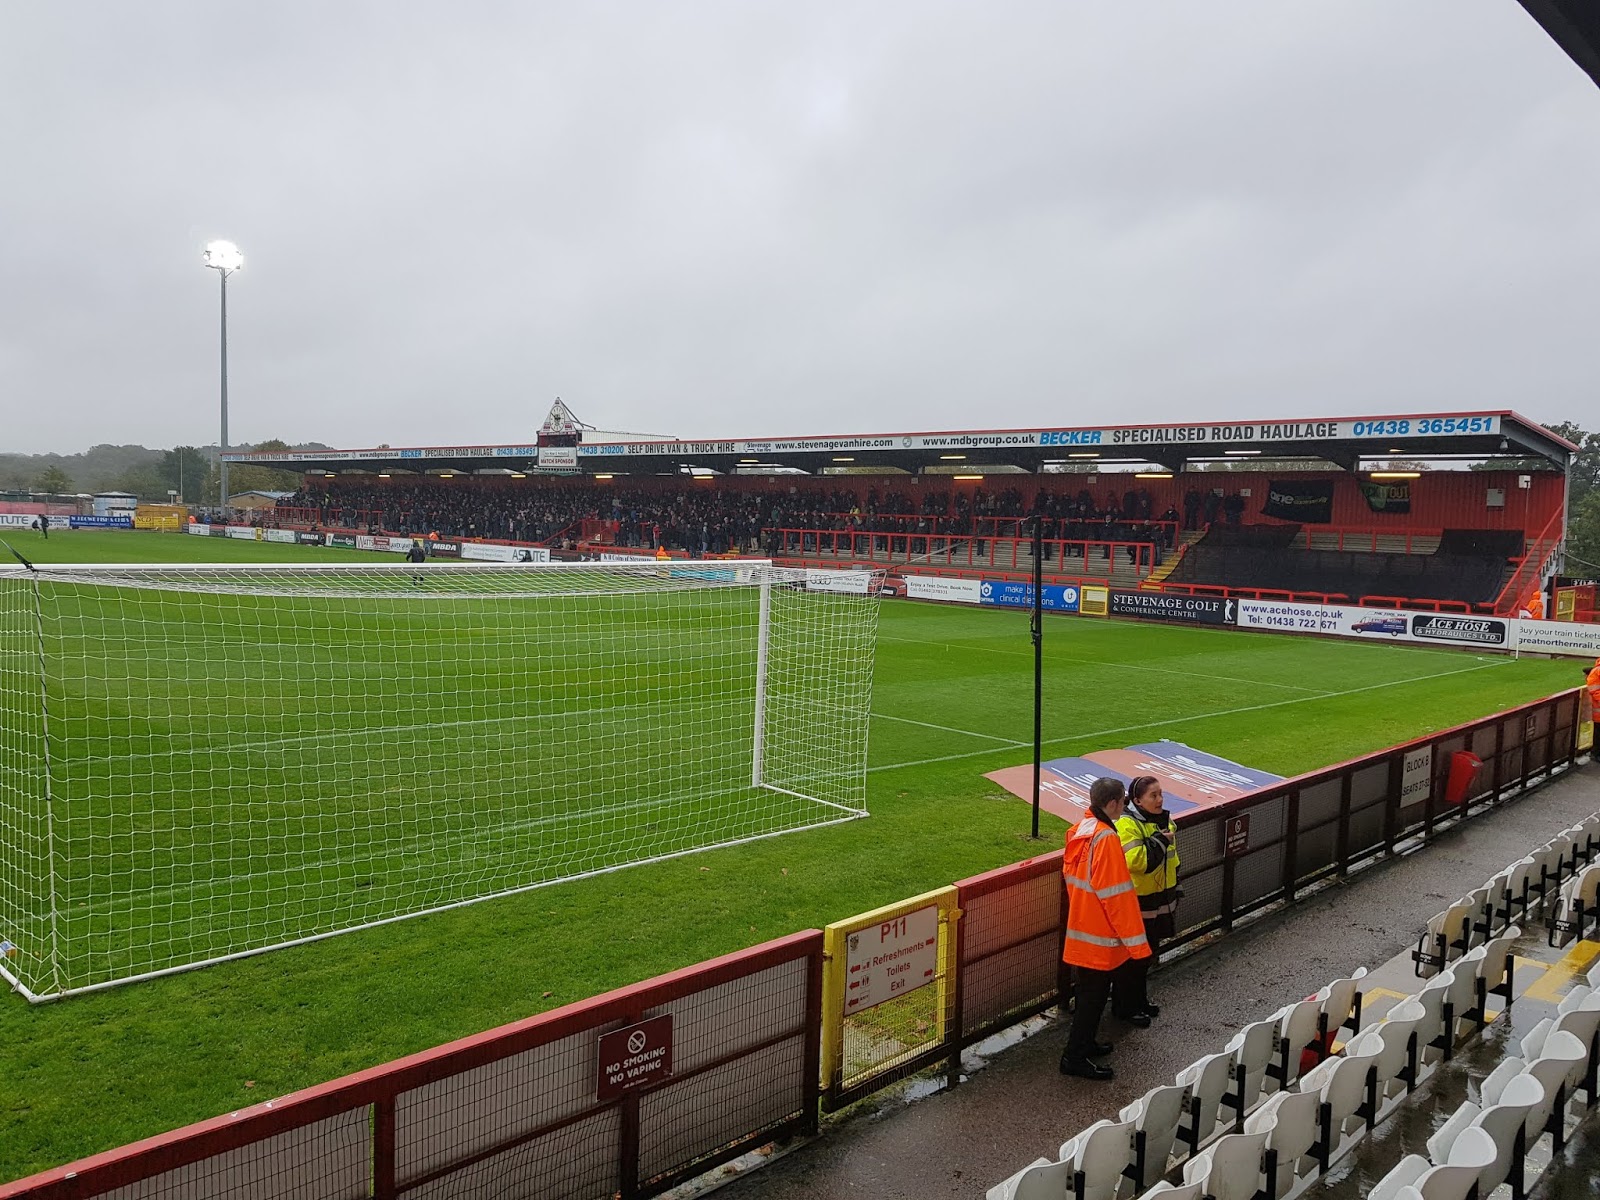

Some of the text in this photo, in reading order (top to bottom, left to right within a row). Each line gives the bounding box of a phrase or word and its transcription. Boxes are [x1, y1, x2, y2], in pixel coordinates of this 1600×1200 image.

[1353, 416, 1493, 436] 01438 365451
[922, 434, 1036, 448] www.mdbgroup.co.uk
[1039, 423, 1338, 446] BECKER SPECIALISED ROAD HAULAGE
[600, 445, 625, 454] 310200
[627, 442, 735, 454] SELF DRIVE VAN & TRUCK HIRE
[774, 438, 893, 450] www.stevenagevanhire.com
[400, 449, 422, 457] BECKER
[456, 448, 469, 457] ROAD
[470, 447, 493, 456] HAULAGE
[1270, 491, 1294, 504] one
[432, 543, 456, 552] MBDA
[512, 549, 546, 562] ASUTE
[1005, 586, 1047, 596] make ber
[1000, 594, 1020, 603] clinical
[1022, 596, 1054, 606] deons
[1113, 594, 1220, 612] STEVENAGE GOLF
[1120, 606, 1166, 616] CONFERENCE
[1168, 610, 1197, 618] CENTRE
[1242, 605, 1344, 619] www.acehose.co.uk
[1248, 614, 1337, 630] Tel: 01438 722 671
[1426, 617, 1492, 633] ACE HOSE
[1425, 629, 1477, 640] HYDRAULICS
[1520, 626, 1600, 640] Buy your train tickets
[1406, 756, 1425, 772] BLOCK
[1402, 782, 1418, 796] SEATS
[881, 917, 906, 944] P11
[872, 942, 924, 967] Refreshments
[886, 962, 911, 978] Toilets
[890, 978, 906, 992] Exit
[606, 1046, 666, 1075] NO SMOKING
[610, 1072, 624, 1085] NO
[627, 1059, 662, 1078] VAPING
